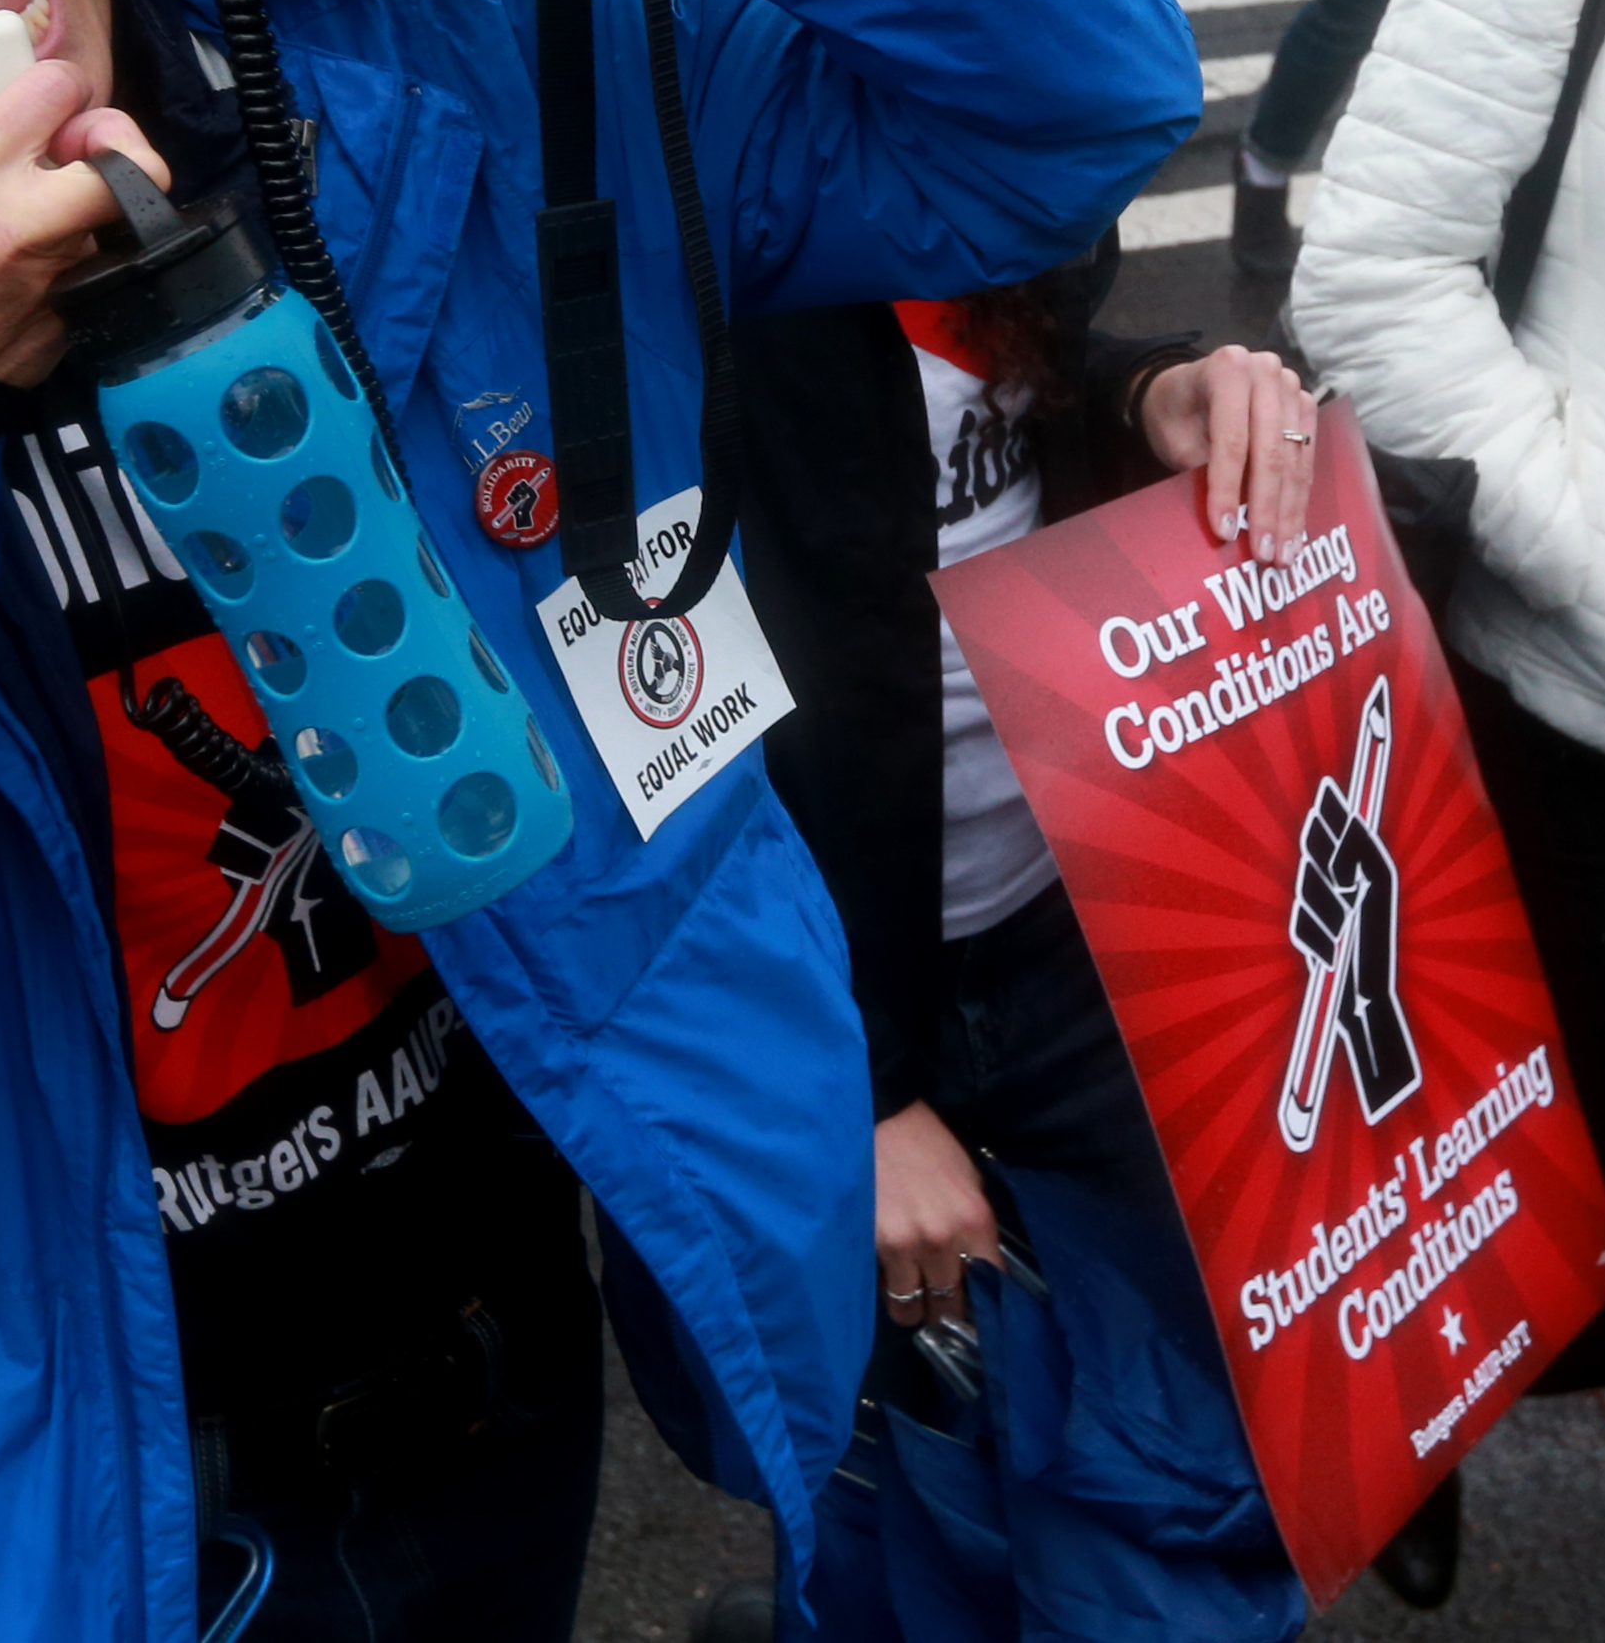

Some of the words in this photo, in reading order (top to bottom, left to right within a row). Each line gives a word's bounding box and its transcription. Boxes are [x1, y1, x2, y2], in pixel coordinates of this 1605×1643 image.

[482, 457, 537, 514] SOLIDARITY
[557, 600, 604, 648] EQU
[646, 520, 695, 570] FOR
[1099, 600, 1207, 679] Our
[1203, 523, 1358, 632] Working
[626, 649, 640, 695] RUTGERS
[1104, 622, 1336, 770] Conditions
[1336, 588, 1391, 656] Are
[636, 735, 699, 803] EQUAL
[690, 681, 758, 749] WORK
[152, 1105, 341, 1234] Rutgers
[1240, 1154, 1408, 1351] Students'
[1409, 1044, 1556, 1201] Learning
[1338, 1169, 1519, 1360] Conditions
[1409, 1394, 1467, 1459] Rutgers
